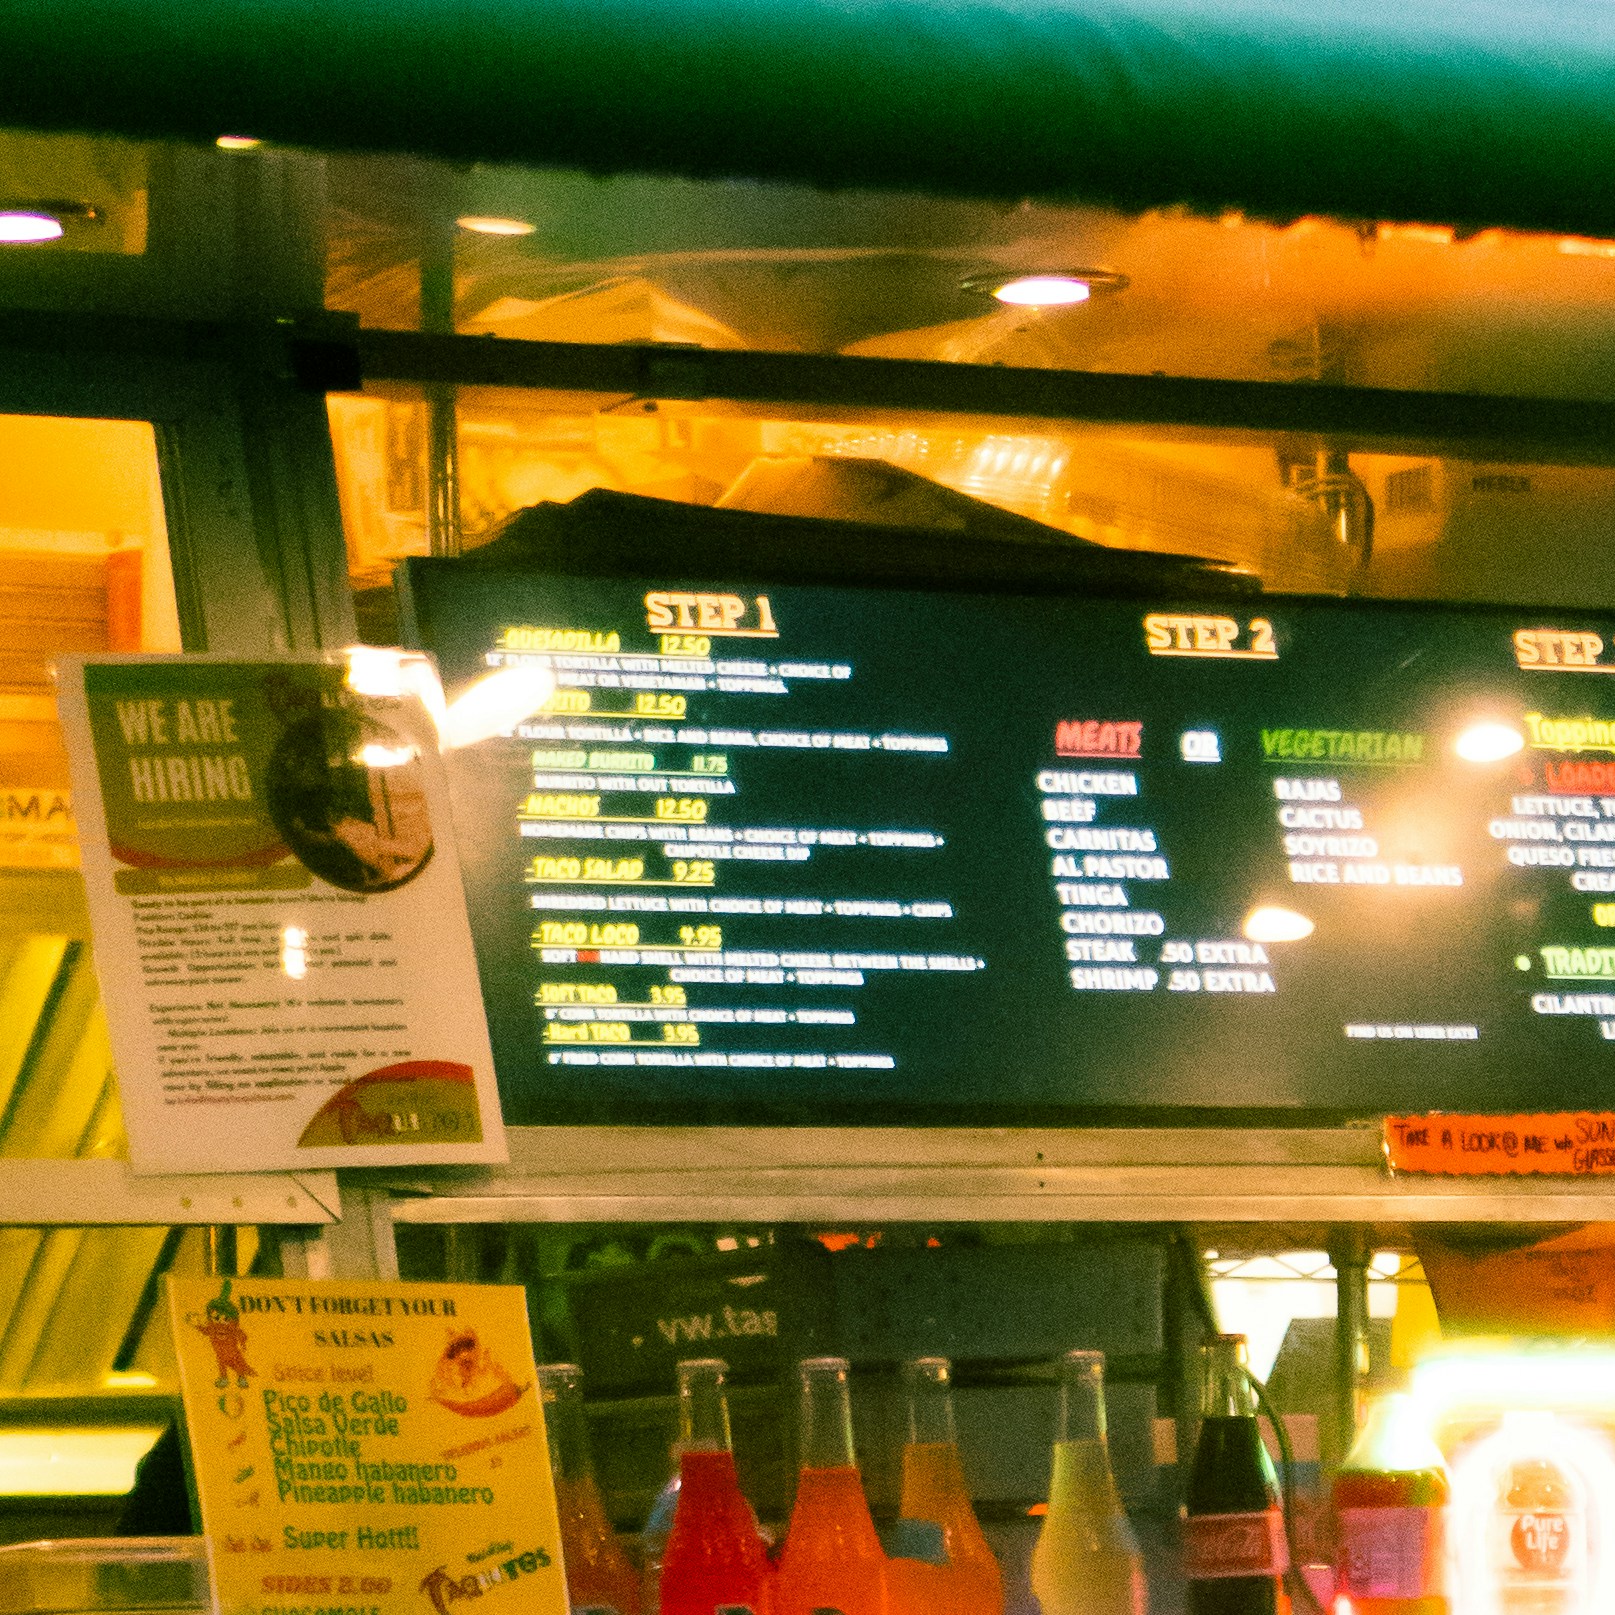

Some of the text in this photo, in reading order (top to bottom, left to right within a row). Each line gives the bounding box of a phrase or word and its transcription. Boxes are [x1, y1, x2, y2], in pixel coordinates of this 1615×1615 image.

[644, 591, 777, 630] STEP 1
[1143, 613, 1276, 652] STEP 2
[660, 635, 711, 657] 12.50
[1512, 629, 1604, 665] STEP
[636, 693, 687, 715] 12.50
[116, 700, 240, 745] WE ARE
[1055, 720, 1424, 760] MEATS OR VEGETARIAN
[129, 755, 254, 801] HIRING
[1037, 770, 1138, 795] CHICKEN
[1273, 777, 1343, 801] RAJAS
[656, 797, 708, 820] 12.50
[1041, 799, 1097, 822] BEEF
[1279, 807, 1364, 830] CACTUS
[1046, 827, 1157, 852] CARNITAS
[1283, 834, 1379, 858] SOYRIZO
[1051, 855, 1170, 880] AL PASTOR
[1507, 846, 1576, 867] QUESO
[582, 857, 645, 880] SALAD
[672, 860, 715, 883] 9.25
[1289, 861, 1464, 887] RICE AND BEANS
[1056, 882, 1129, 907] TINGA
[589, 922, 640, 946] LOCO
[1060, 911, 1165, 936] CHORIZO
[1065, 938, 1138, 962] STEAK
[1195, 941, 1270, 964] EXTRA
[1070, 967, 1159, 991] SHRIMP
[1202, 970, 1277, 993] EXTRA
[238, 1295, 457, 1317] DON'T FORGET YOUR
[313, 1329, 396, 1348] SALSAS
[263, 1389, 408, 1414] Pico de Gallo
[265, 1412, 400, 1438] Salsa Verde
[269, 1436, 361, 1460] Chipotle
[273, 1458, 458, 1482] Mango habanero
[277, 1481, 495, 1505] Pineapple habanero
[1520, 1513, 1564, 1533] Pure
[282, 1525, 349, 1550] Super
[1525, 1531, 1560, 1553] Life
